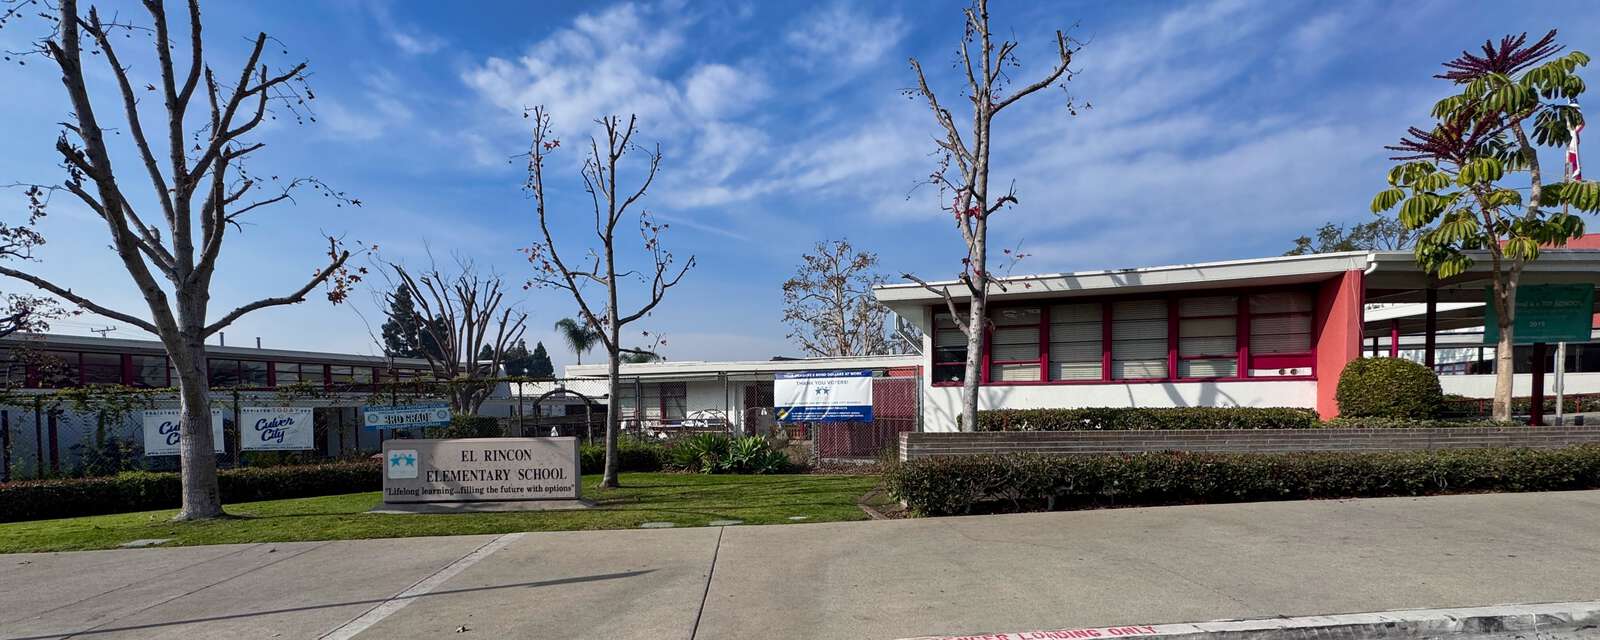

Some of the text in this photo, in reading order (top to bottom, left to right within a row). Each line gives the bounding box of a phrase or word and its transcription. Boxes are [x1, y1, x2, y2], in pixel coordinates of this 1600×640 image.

[255, 417, 295, 431] Culver
[384, 414, 404, 424] 3RD
[405, 412, 433, 423] GRADE
[159, 420, 181, 435] Cul
[261, 427, 287, 443] City
[461, 449, 532, 462] EL RINCON
[426, 468, 568, 483] ELEMENTARY SCHOOL
[385, 487, 420, 497] "Lifelong
[486, 486, 499, 494] the
[500, 485, 525, 493] future
[526, 485, 543, 493] with
[544, 484, 575, 494] options"
[1107, 626, 1158, 636] ONLY
